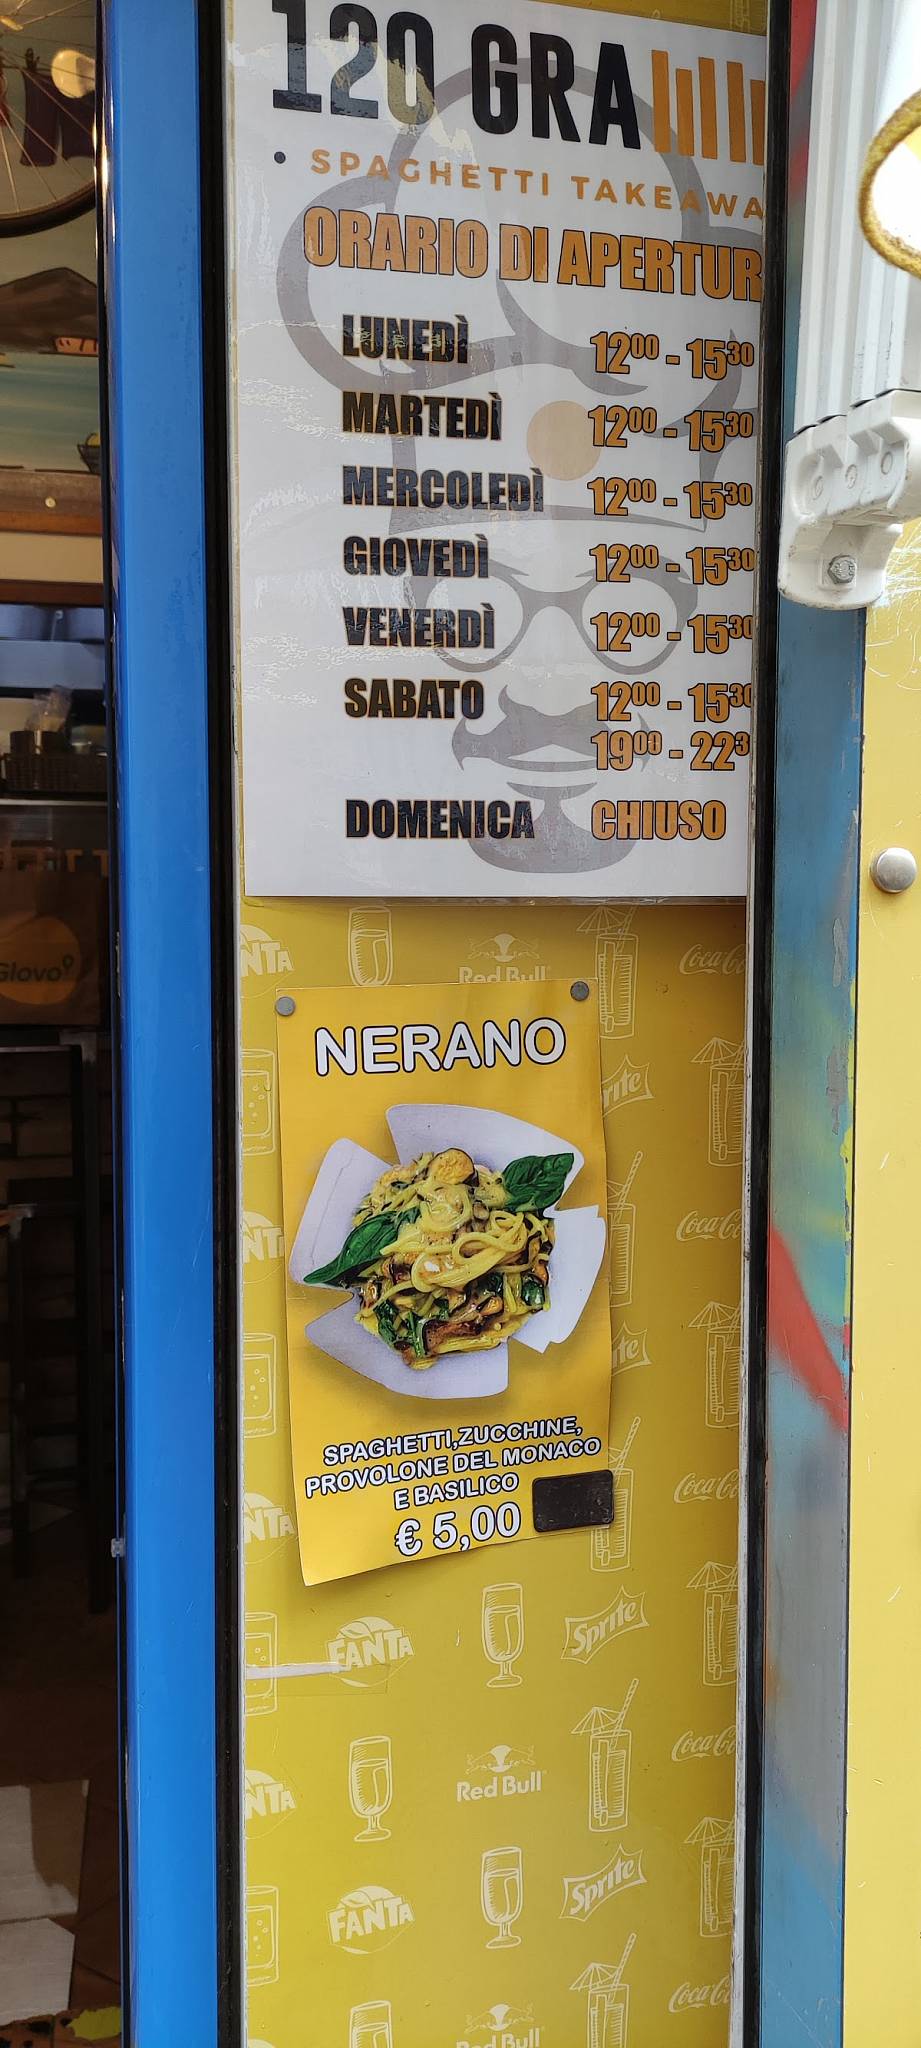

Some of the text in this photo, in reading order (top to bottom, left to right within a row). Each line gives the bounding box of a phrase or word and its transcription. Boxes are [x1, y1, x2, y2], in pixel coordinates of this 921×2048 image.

[272, 0, 434, 127] 120
[310, 148, 764, 220] SPAGHETTI TAKEAWA
[303, 206, 763, 303] ORARIO DI APERTUR
[342, 314, 469, 364] LUNEDÌ
[342, 390, 503, 441] MARTEDÌ
[342, 465, 545, 513] MERCOLEDÌ
[342, 534, 490, 579] GIOVEDÌ
[341, 602, 496, 649] VENERDÌ
[343, 677, 485, 721] SABATO
[345, 799, 727, 840] DOMENICA CHIUSO
[315, 1017, 567, 1077] NERANO
[305, 1436, 602, 1499] PROVOLONE DEL MONACO
[393, 1472, 520, 1511] E BASILICO
[393, 1501, 522, 1557] € 5,00
[327, 1628, 415, 1675] FANTA
[571, 1599, 638, 1657] Sprite
[456, 1770, 542, 1802] Red Bull
[570, 1857, 635, 1915] Sprite
[327, 1896, 415, 1945] FANTA
